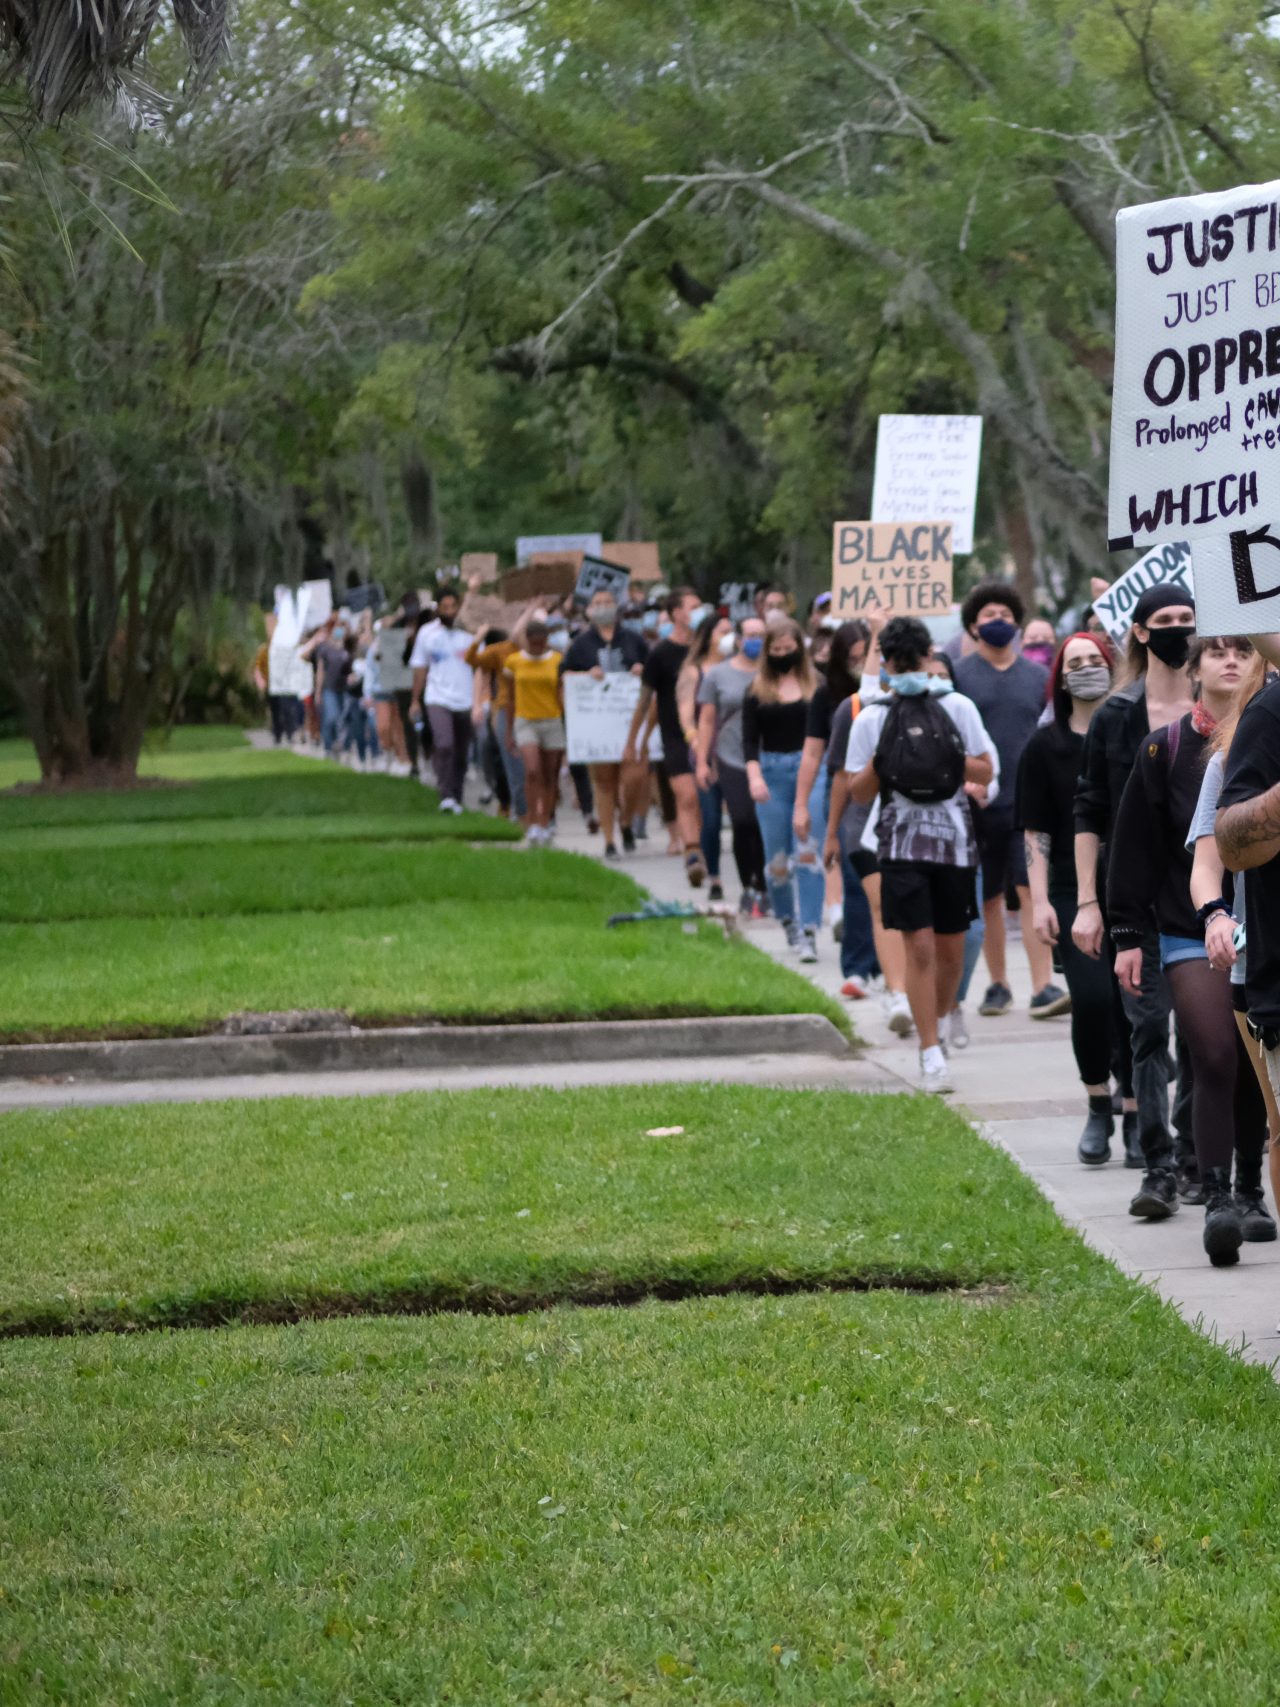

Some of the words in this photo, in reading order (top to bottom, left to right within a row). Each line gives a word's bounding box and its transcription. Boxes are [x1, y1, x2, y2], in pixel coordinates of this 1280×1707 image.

[1164, 279, 1237, 329] JUST
[1136, 402, 1231, 453] Prolonged
[1128, 471, 1259, 534] WHICH
[839, 525, 953, 565] BLACK
[839, 582, 948, 611] MATTER
[861, 566, 931, 581] LIVES
[1096, 572, 1147, 622] YOU
